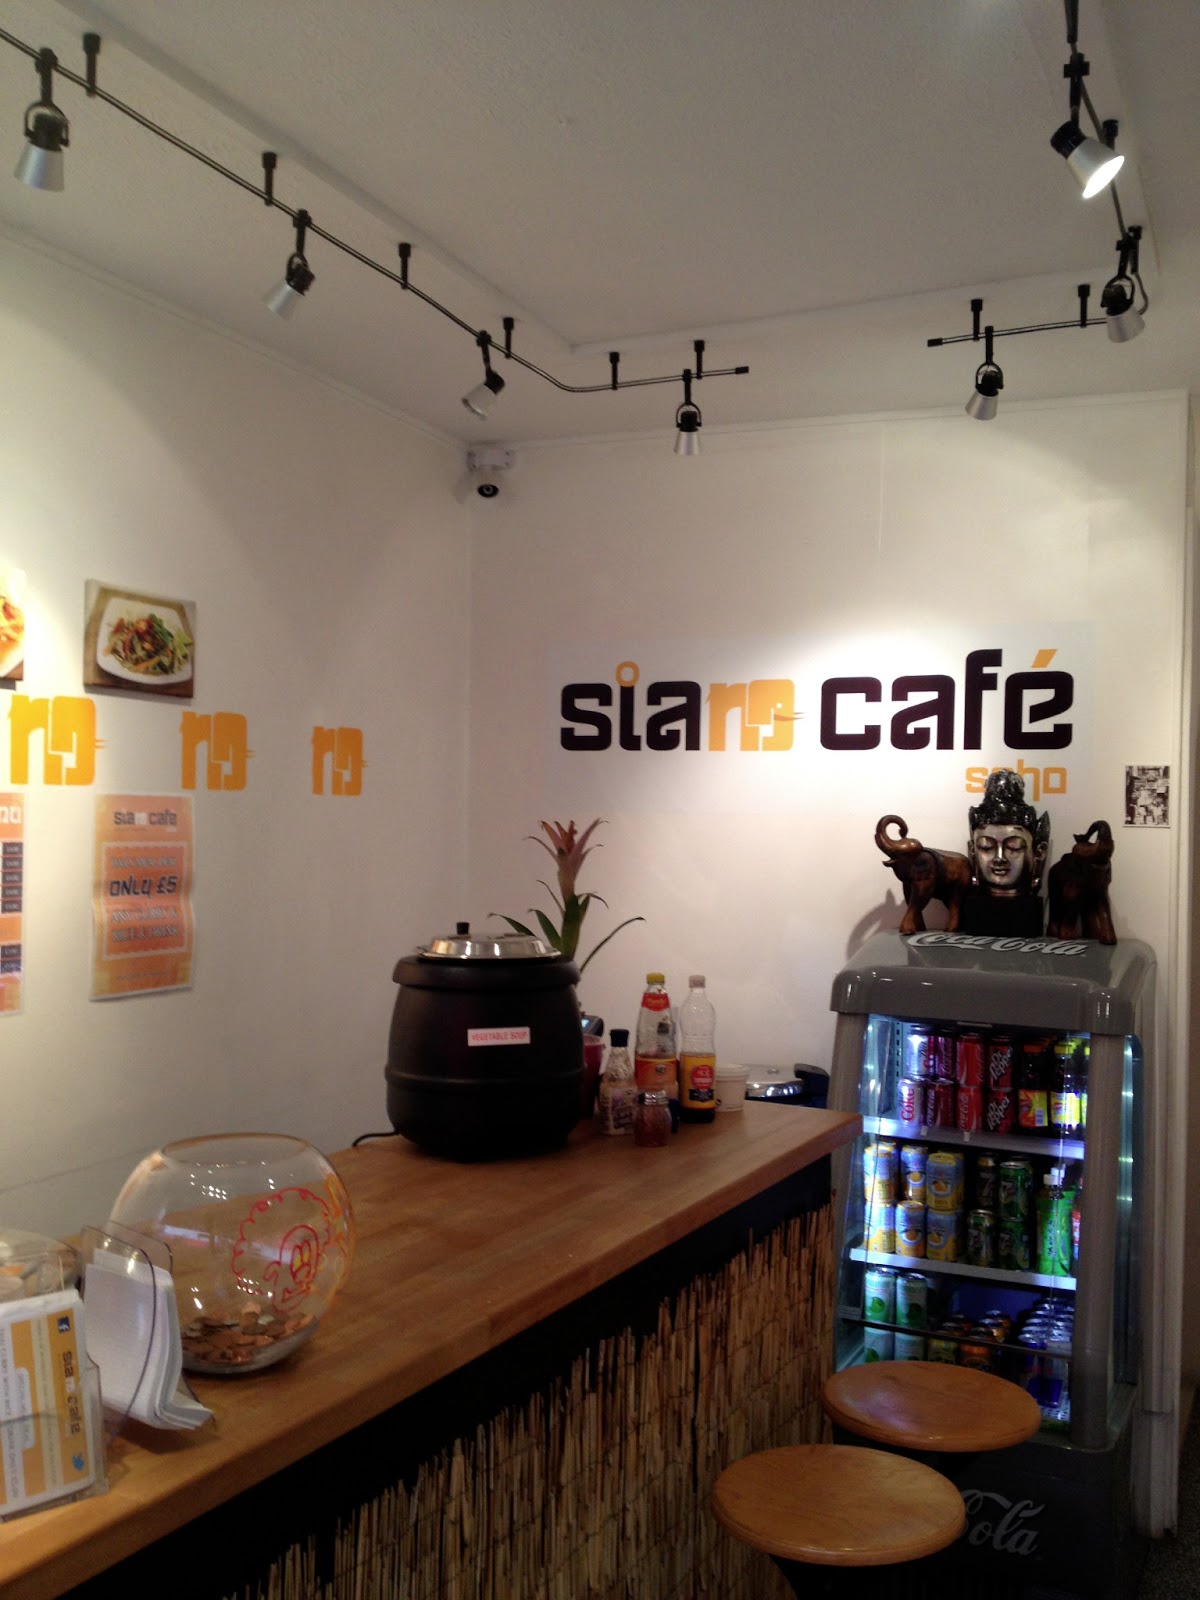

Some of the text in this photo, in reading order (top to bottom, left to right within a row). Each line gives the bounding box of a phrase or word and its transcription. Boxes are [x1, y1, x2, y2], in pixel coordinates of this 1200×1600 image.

[819, 648, 1075, 751] café
[965, 759, 1068, 802] sho
[109, 874, 152, 898] ONLY
